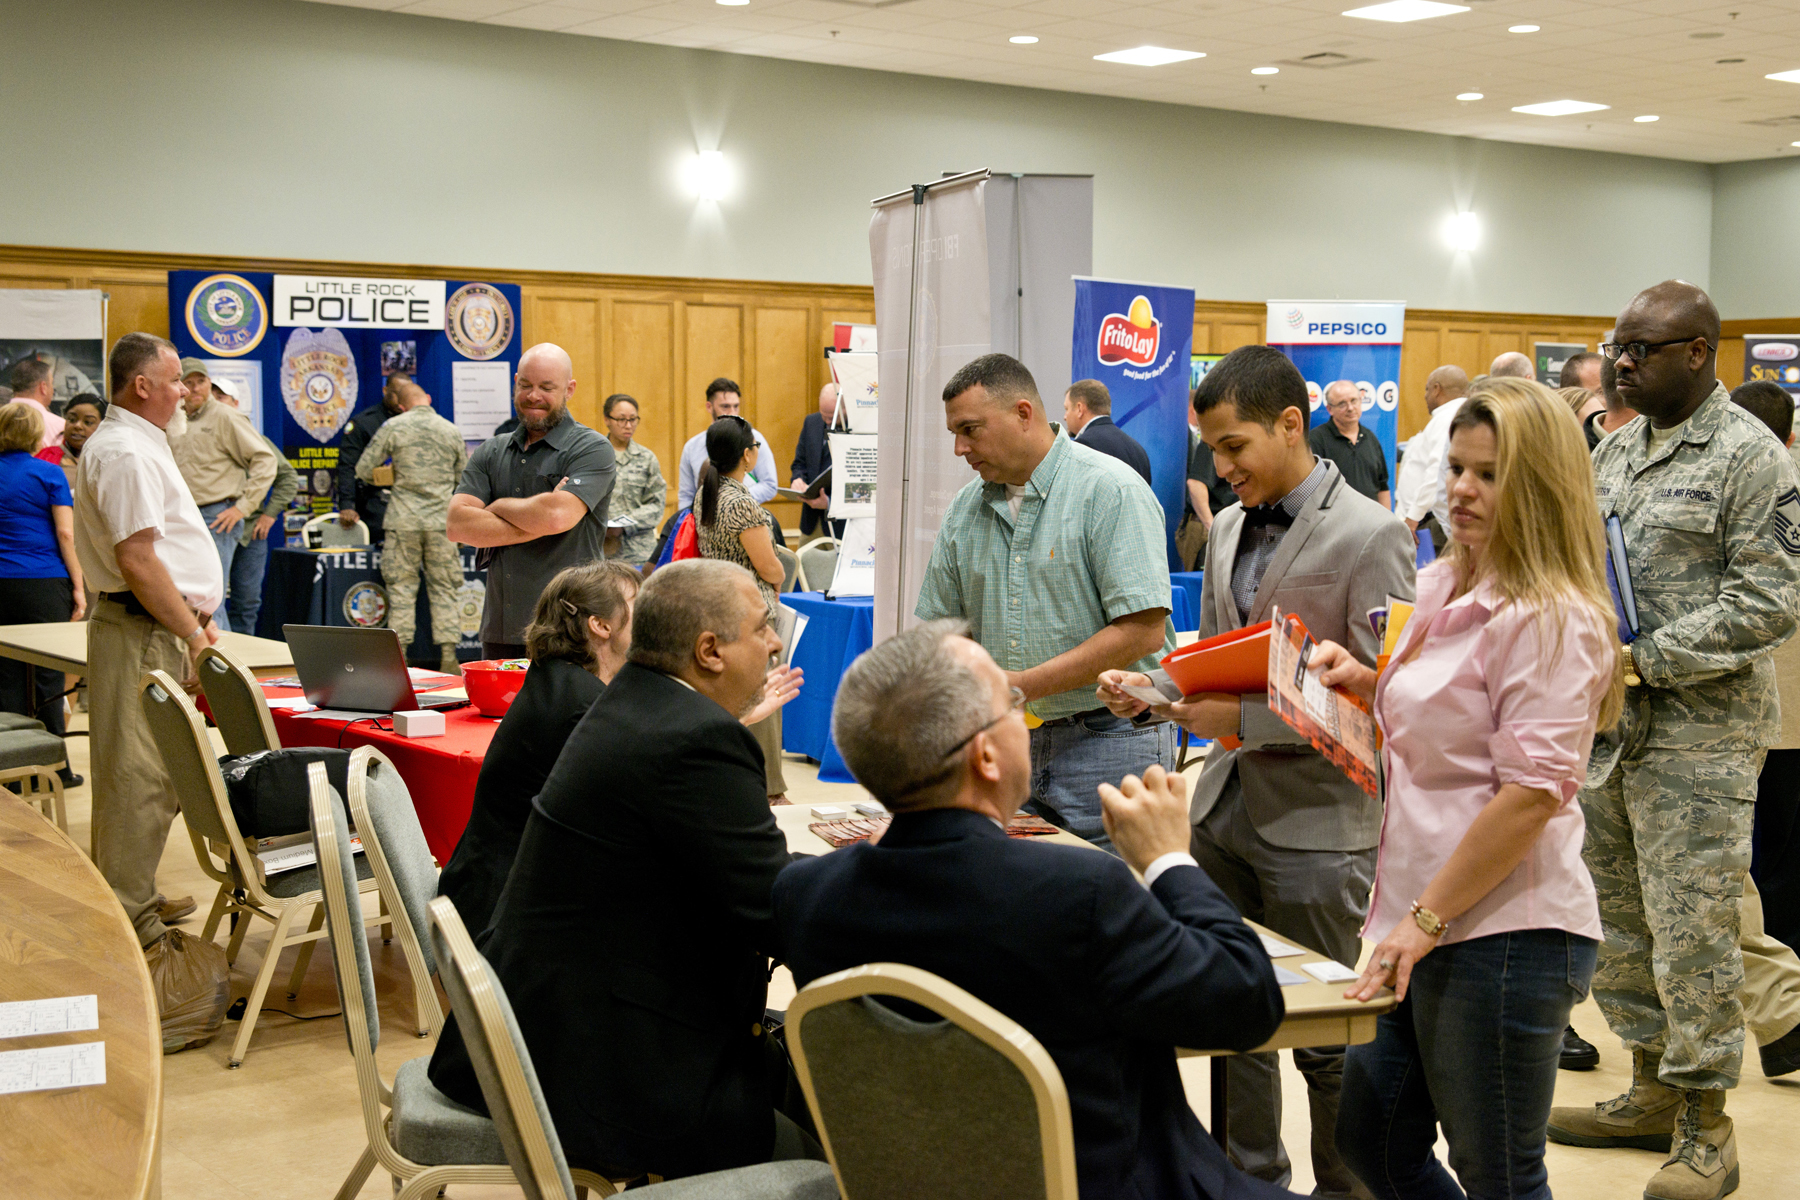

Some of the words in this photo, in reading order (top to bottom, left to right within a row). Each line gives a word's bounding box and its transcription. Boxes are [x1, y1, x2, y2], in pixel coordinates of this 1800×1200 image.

[305, 281, 362, 296] LITTLE
[366, 284, 416, 297] ROCK
[290, 295, 430, 324] POLICE
[212, 327, 252, 345] POLICE
[1308, 322, 1388, 336] PEPSICO
[292, 353, 320, 368] LITTLE
[324, 353, 344, 366] ROCK
[1123, 368, 1134, 378] good
[1134, 371, 1145, 380] food
[1384, 388, 1394, 403] G
[298, 448, 322, 458] LITTLE
[324, 448, 340, 458] ROC
[288, 459, 311, 469] OLICE
[1661, 488, 1672, 498] U.S.
[1673, 488, 1685, 498] AIR
[1685, 489, 1712, 501] FORCE
[281, 849, 314, 860] Medium
